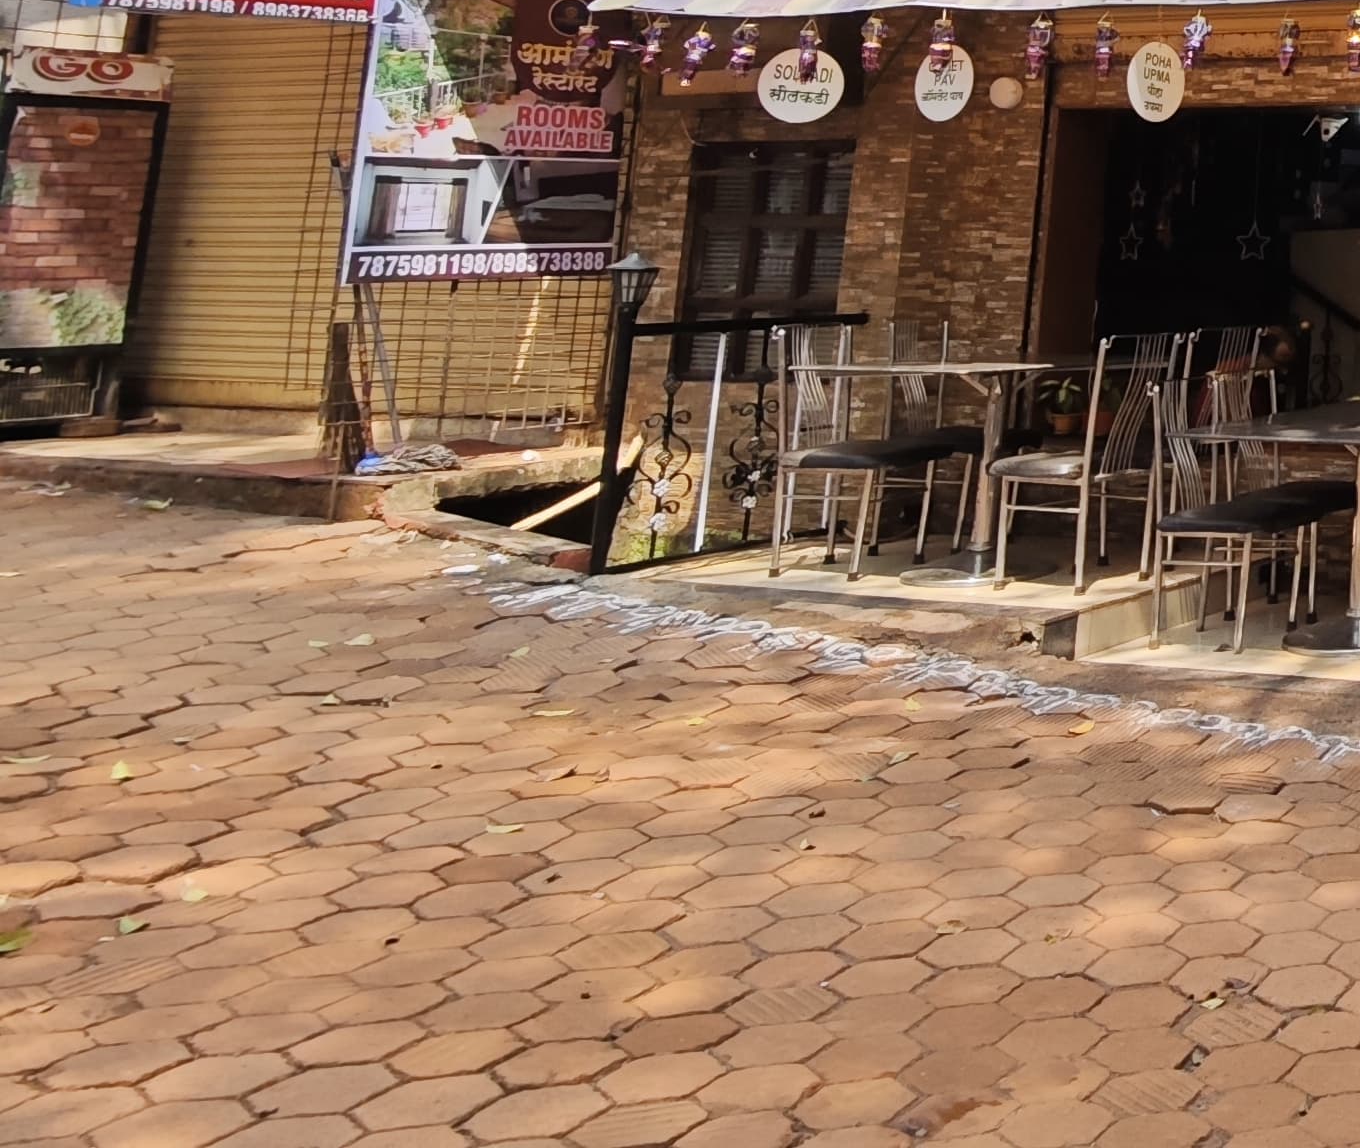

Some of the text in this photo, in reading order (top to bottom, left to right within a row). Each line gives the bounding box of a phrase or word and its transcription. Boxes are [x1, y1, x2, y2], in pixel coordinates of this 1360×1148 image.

[240, 2, 249, 15] /
[517, 40, 615, 69] आमंण
[1145, 52, 1172, 69] POHA
[1143, 67, 1171, 84] UPMA
[515, 104, 605, 130] ROOMS
[504, 129, 612, 150] AVAILABLE
[358, 252, 605, 277] 7875981198/8983738388
